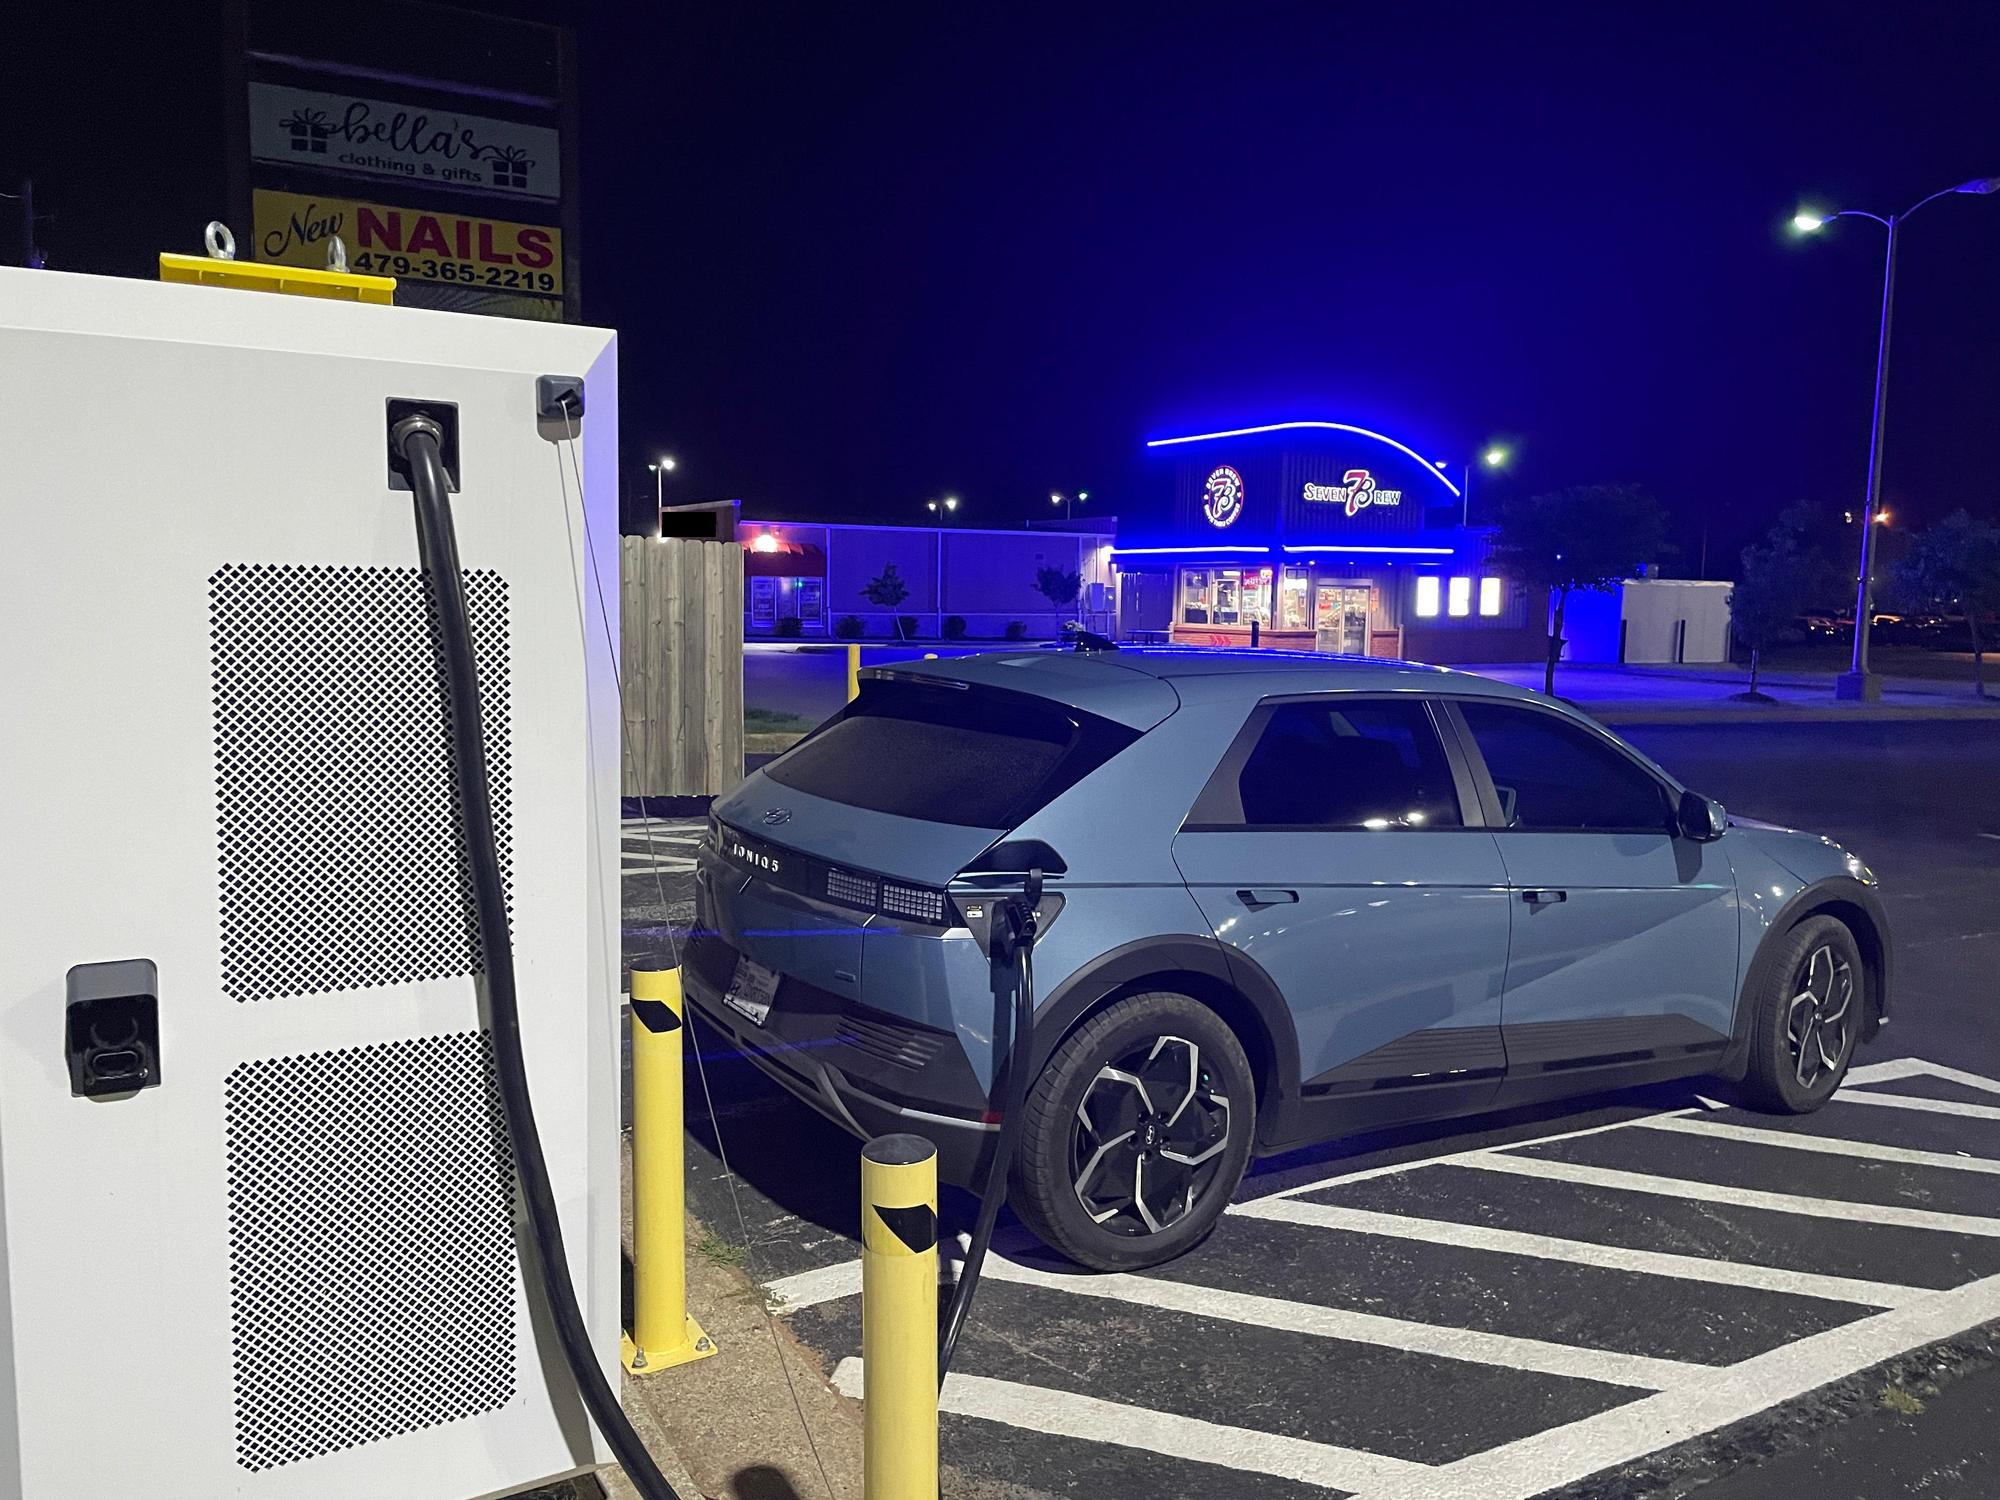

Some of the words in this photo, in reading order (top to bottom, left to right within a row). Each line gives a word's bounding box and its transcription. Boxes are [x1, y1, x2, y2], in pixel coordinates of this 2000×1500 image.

[337, 102, 488, 159] bella's
[338, 152, 416, 176] clothing
[422, 163, 436, 175] &
[441, 165, 482, 183] gifts
[263, 203, 344, 258] New
[356, 206, 554, 269] NAILS
[353, 251, 555, 292] 479-365-2219
[733, 843, 769, 869] IONIQ
[771, 859, 779, 872] 5
